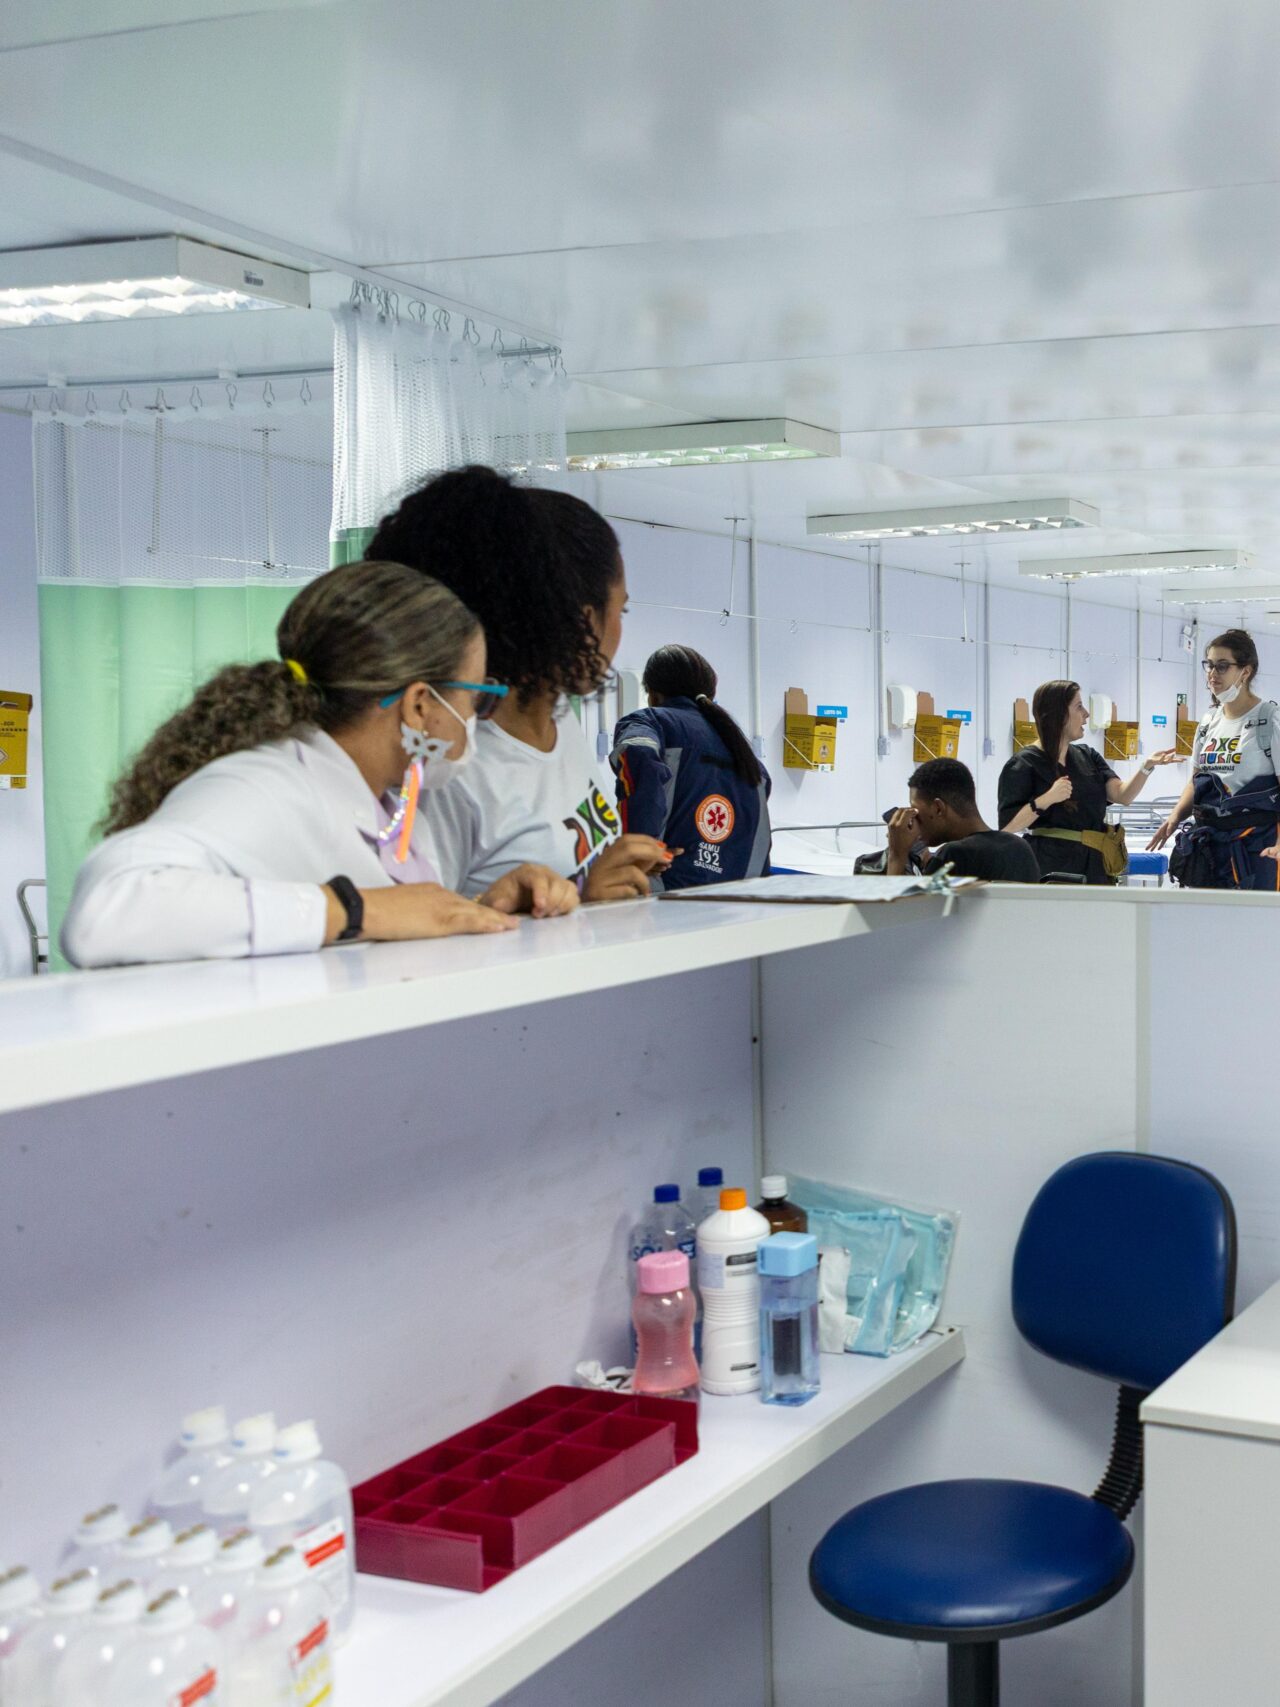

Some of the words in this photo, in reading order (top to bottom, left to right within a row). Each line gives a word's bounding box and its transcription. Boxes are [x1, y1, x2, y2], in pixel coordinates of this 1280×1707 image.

[698, 842, 721, 853] SAMU
[697, 848, 720, 867] 192
[693, 860, 724, 875] SALVADOR
